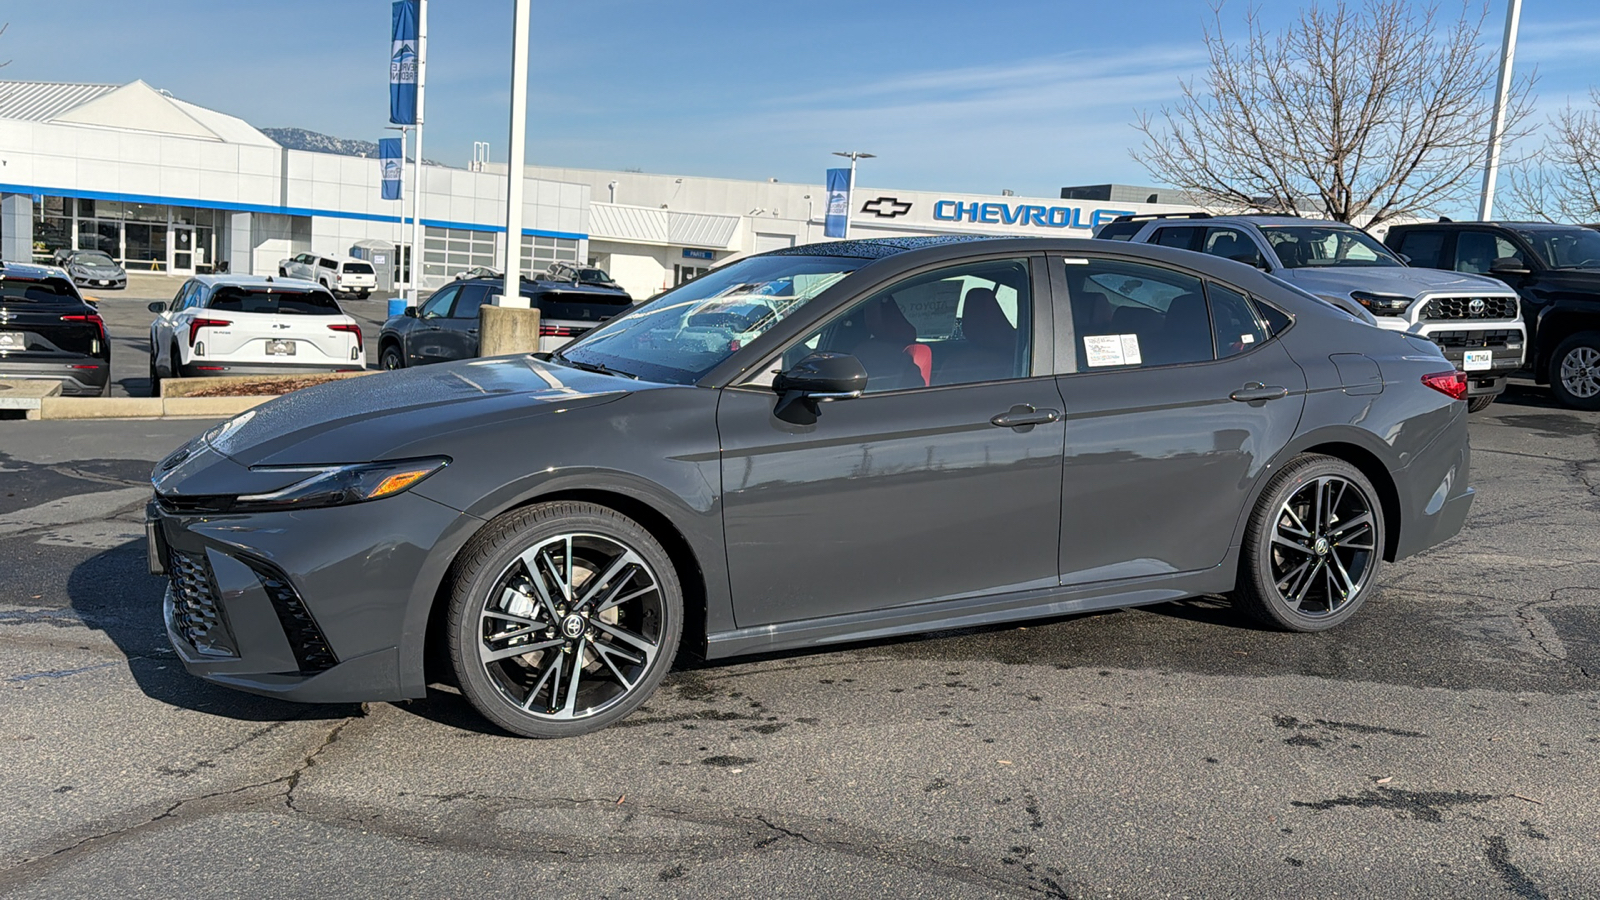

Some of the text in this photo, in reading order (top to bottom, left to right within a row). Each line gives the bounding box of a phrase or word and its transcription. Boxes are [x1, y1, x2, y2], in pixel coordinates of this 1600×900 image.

[690, 250, 706, 258] PARTS
[909, 300, 948, 311] TOYOTA
[1471, 354, 1489, 362] LITHIA
